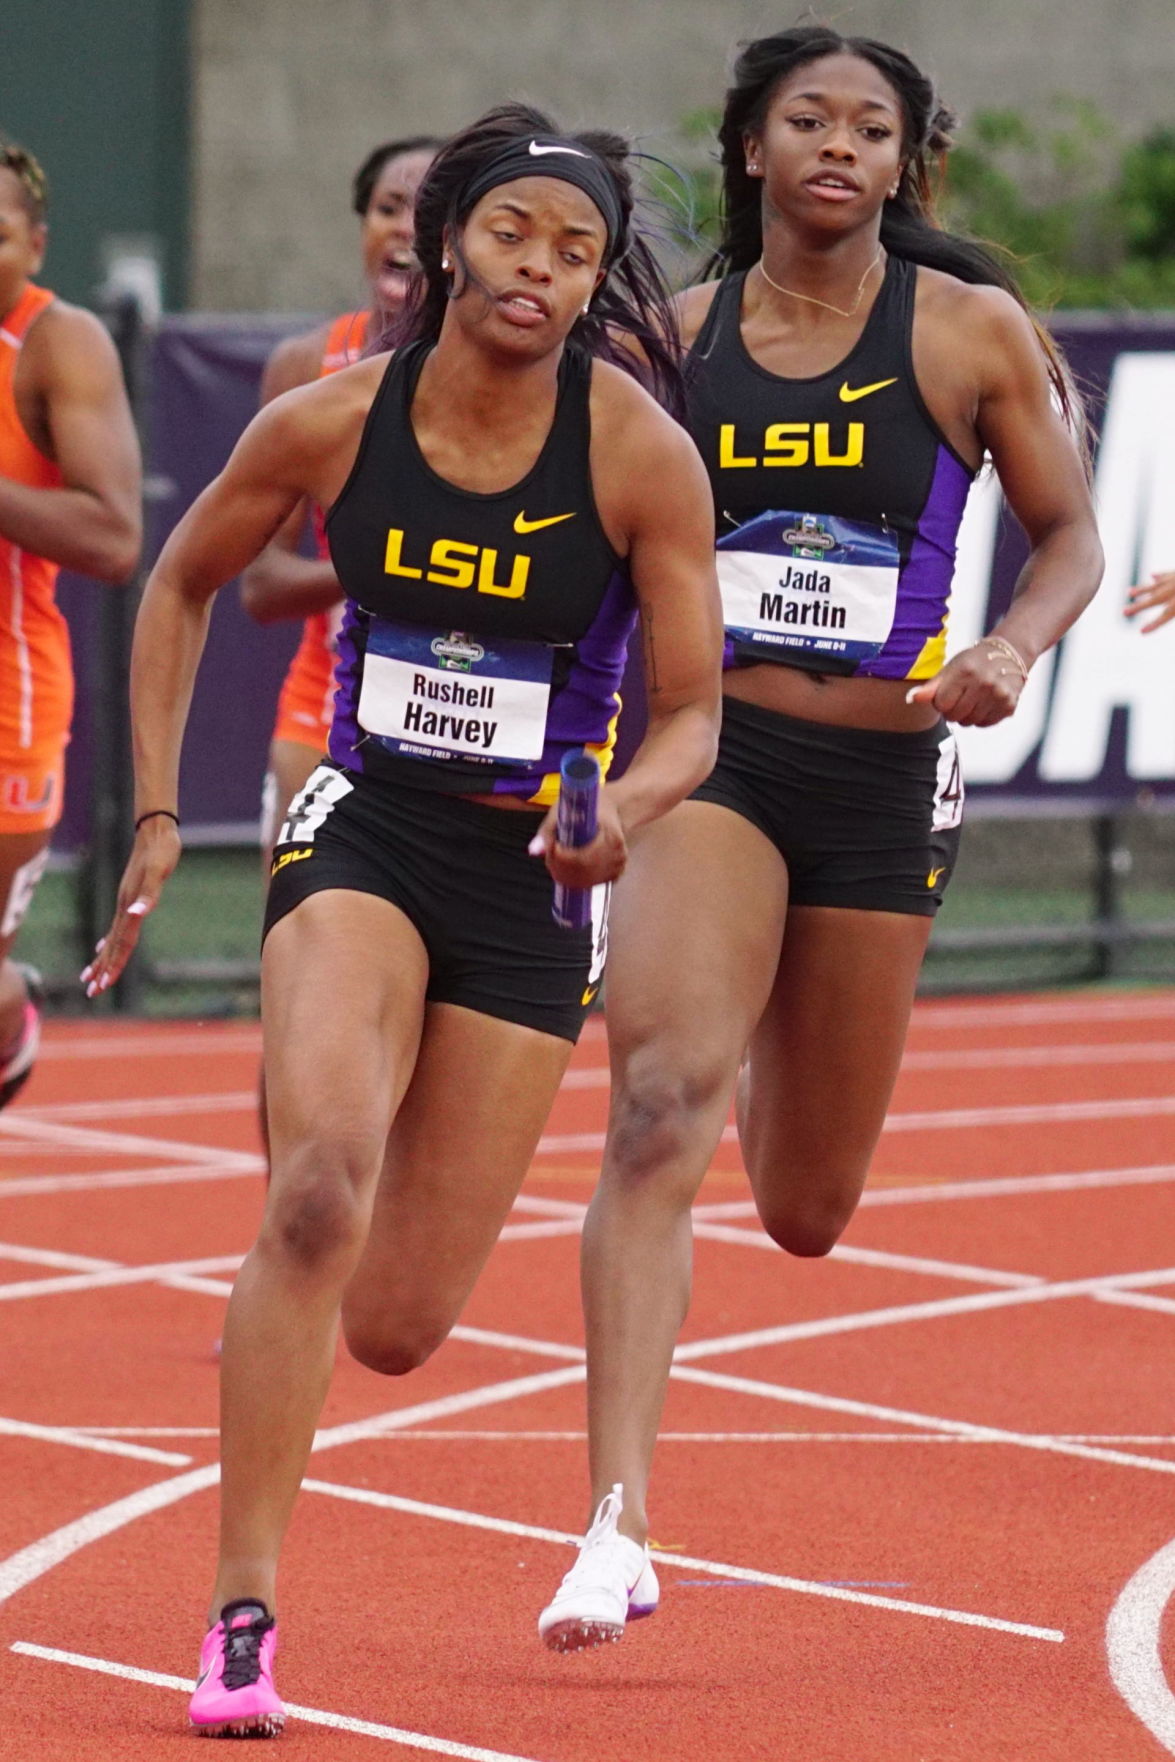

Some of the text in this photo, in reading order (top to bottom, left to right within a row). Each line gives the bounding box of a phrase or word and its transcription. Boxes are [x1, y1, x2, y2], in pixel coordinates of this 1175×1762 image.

[719, 422, 864, 468] LSU
[384, 528, 531, 600] LSU
[779, 566, 831, 594] Jada
[759, 592, 846, 629] Martin
[752, 632, 785, 645] HAYWARD
[785, 637, 804, 647] FIELD
[412, 673, 495, 710] Rushell
[403, 701, 498, 748] Harvey
